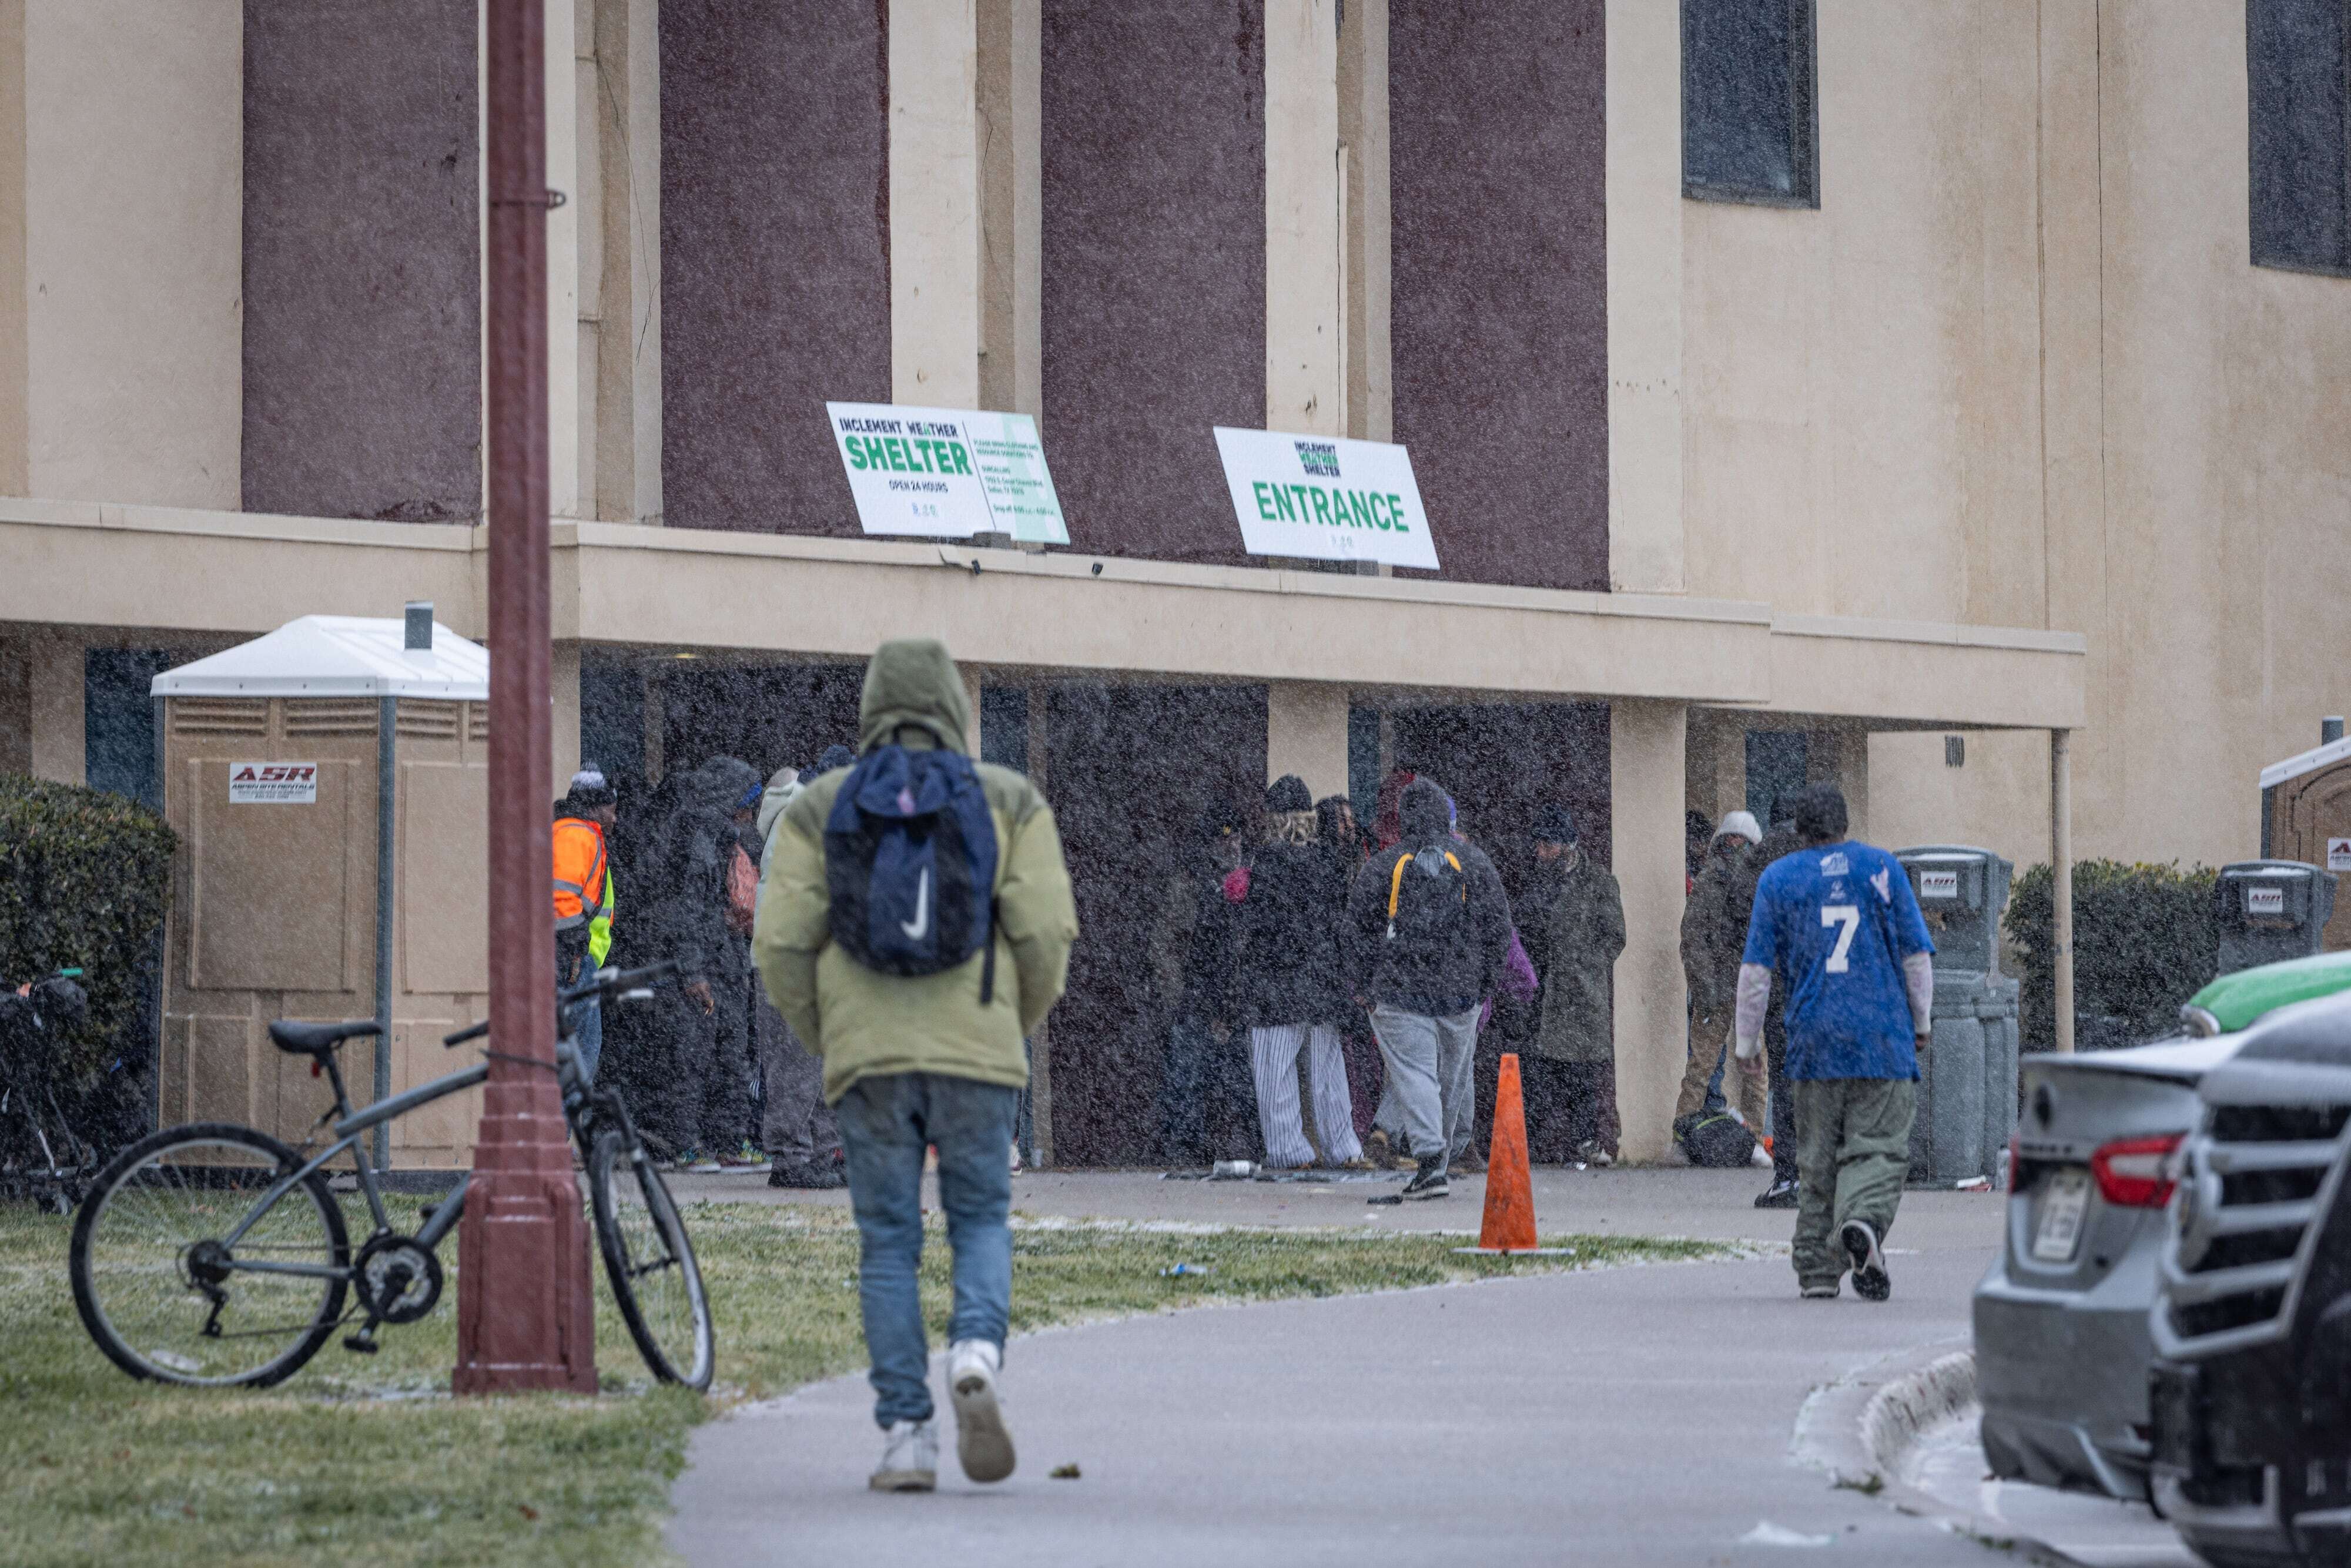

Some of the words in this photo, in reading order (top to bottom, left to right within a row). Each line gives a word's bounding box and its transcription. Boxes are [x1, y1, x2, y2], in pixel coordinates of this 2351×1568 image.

[839, 417, 902, 435] INCLEMENT
[907, 421, 958, 437] WEATHER
[845, 435, 973, 475] SHELTER
[1295, 441, 1335, 453] INCLEMENT
[1303, 464, 1341, 477] SHELTER
[889, 480, 910, 491] OPEN
[910, 480, 922, 492] 24
[922, 481, 949, 494] HOURS
[1252, 481, 1410, 532] ENTRANCE
[233, 766, 316, 781] ASR
[1821, 905, 1860, 973] 7
